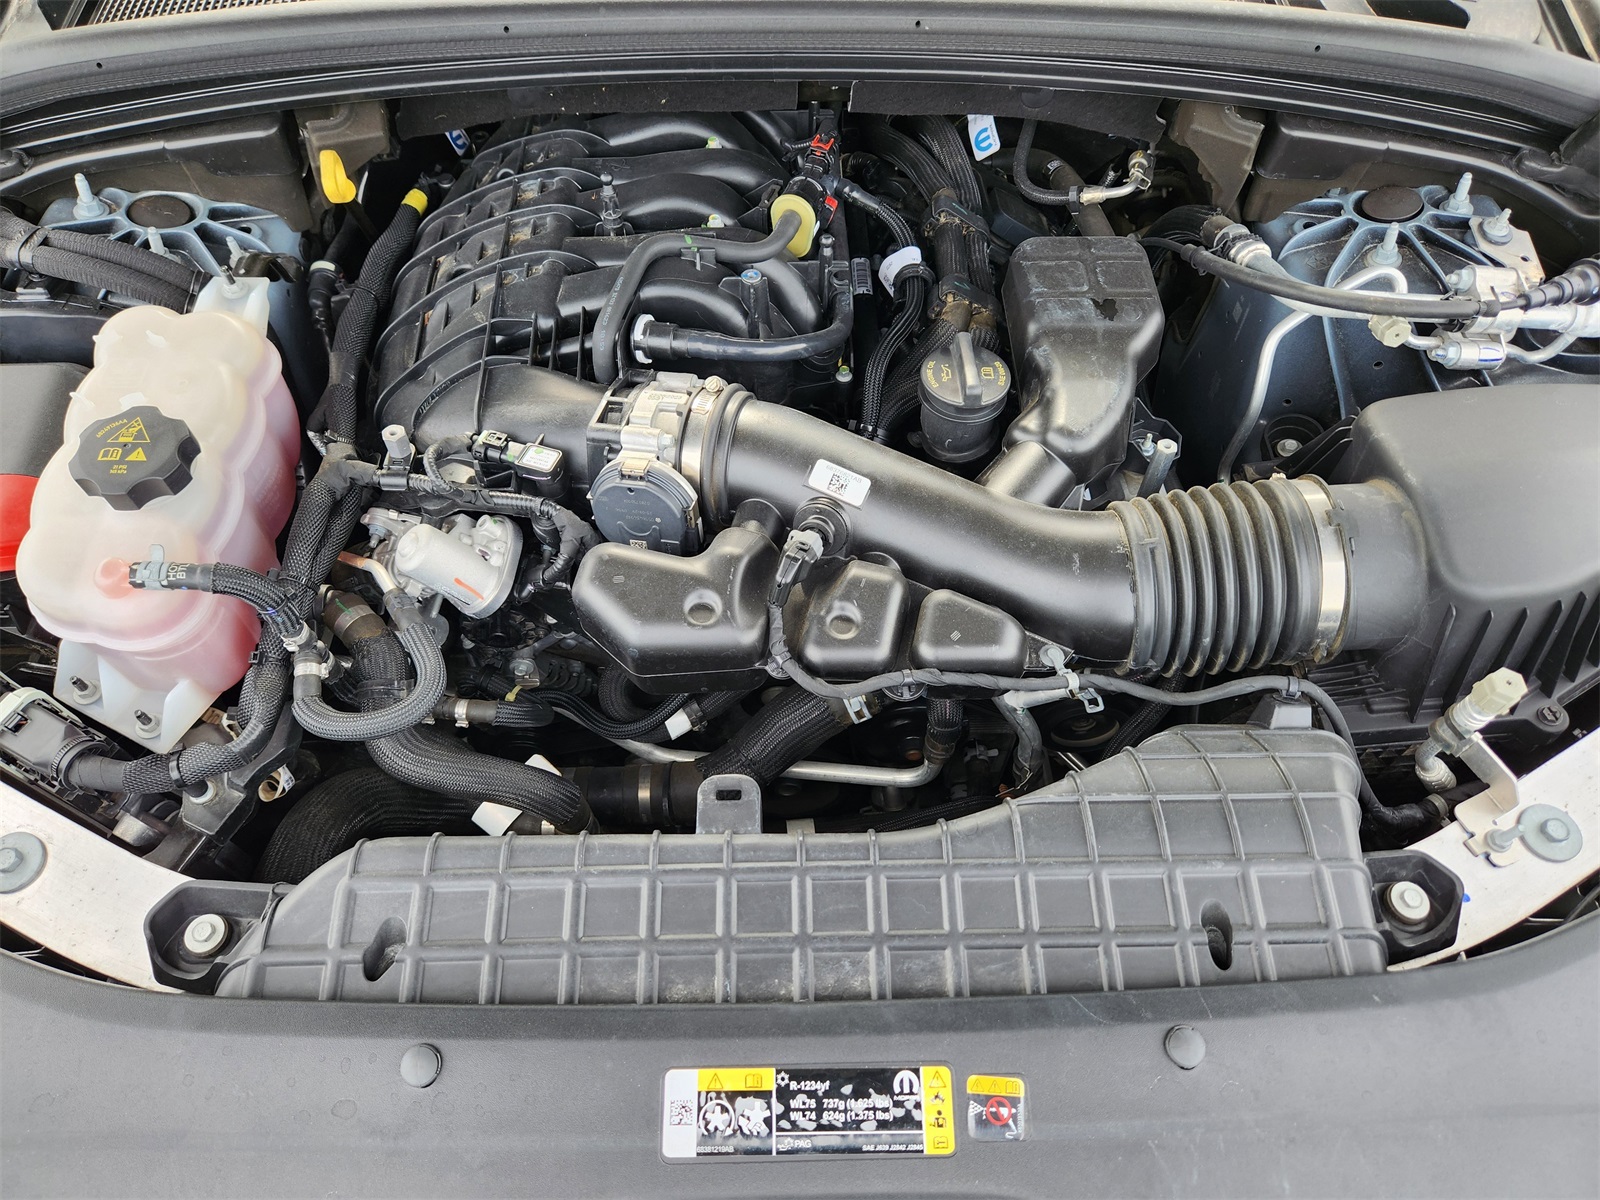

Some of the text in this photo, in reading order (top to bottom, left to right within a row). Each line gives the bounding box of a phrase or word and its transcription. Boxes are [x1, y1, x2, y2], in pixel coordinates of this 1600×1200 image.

[790, 1081, 830, 1092] R-1234yf
[790, 1098, 893, 1110] WL75 737g (1.625 lbs)
[790, 1110, 894, 1122] WL74 624g (1.375 lbs)
[795, 1140, 811, 1148] PAG
